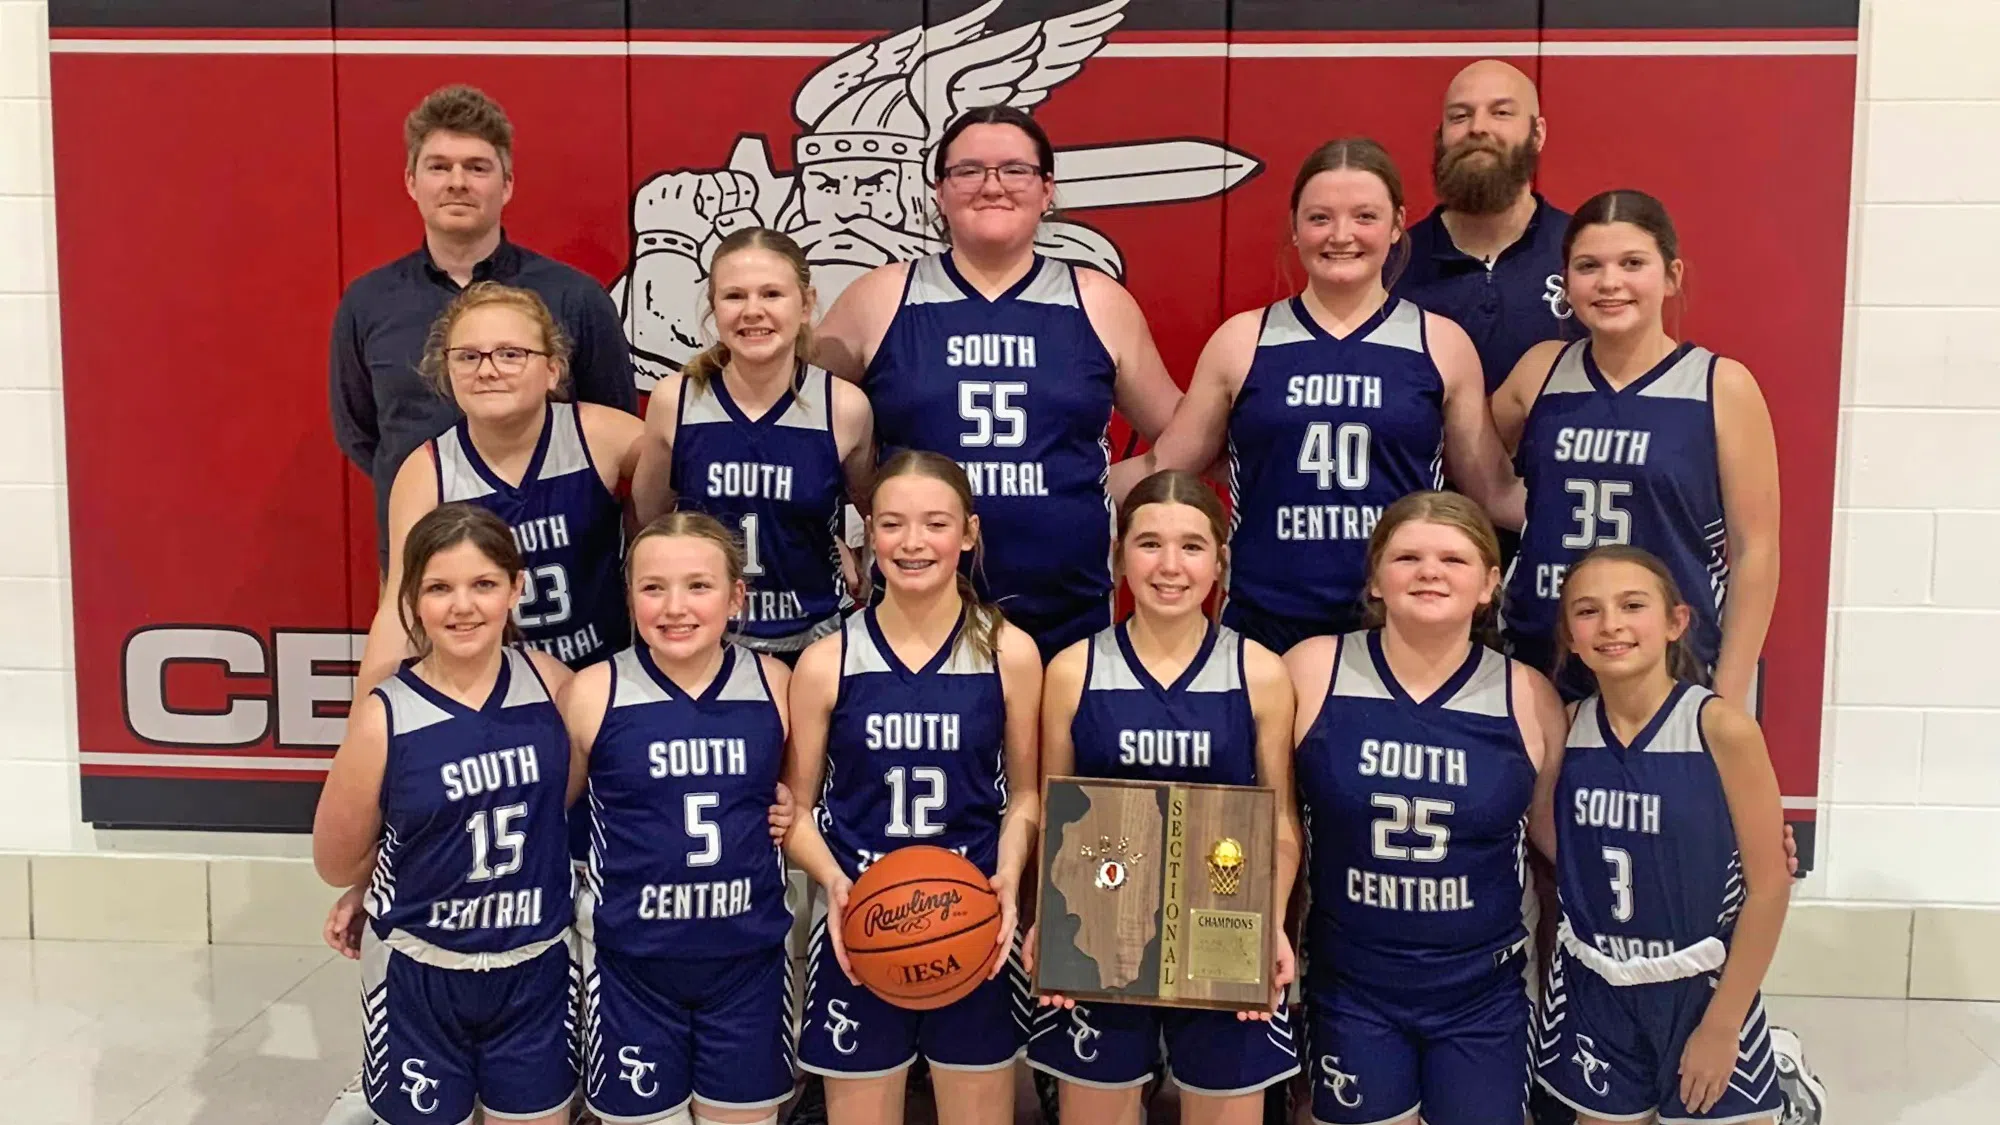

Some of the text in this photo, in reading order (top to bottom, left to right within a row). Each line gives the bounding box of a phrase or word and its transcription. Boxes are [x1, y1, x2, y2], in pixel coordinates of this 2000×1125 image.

[946, 333, 1036, 368] SOUTH
[958, 380, 1028, 448] 55
[1286, 374, 1382, 408] SOUTH
[1297, 421, 1371, 490] 40
[1554, 427, 1651, 465] SOUTH
[706, 462, 793, 501] SOUTH
[955, 461, 1049, 497] NTRAL
[1562, 478, 1633, 550] 35
[739, 512, 765, 576] 1
[512, 562, 573, 628] 23
[727, 589, 810, 622] TRAL
[120, 622, 372, 750] CE
[865, 712, 960, 751] SOUTH
[1119, 728, 1212, 768] SOUTH
[440, 744, 541, 801] SOUTH
[648, 738, 747, 779] SOUTH
[1357, 738, 1468, 787] SOUTH
[884, 766, 948, 838] 12
[1574, 786, 1661, 835] SOUTH
[465, 801, 528, 884] 15
[683, 791, 722, 868] 5
[1370, 792, 1456, 863] 25
[637, 876, 753, 921] CENTRAL
[1163, 800, 1183, 986] SECTIONAL
[1346, 866, 1476, 913] CENTRAL
[1601, 845, 1634, 924] 3
[864, 888, 962, 938] Rawlings
[1198, 915, 1254, 930] CHAMPIONS
[903, 954, 961, 985] IESA
